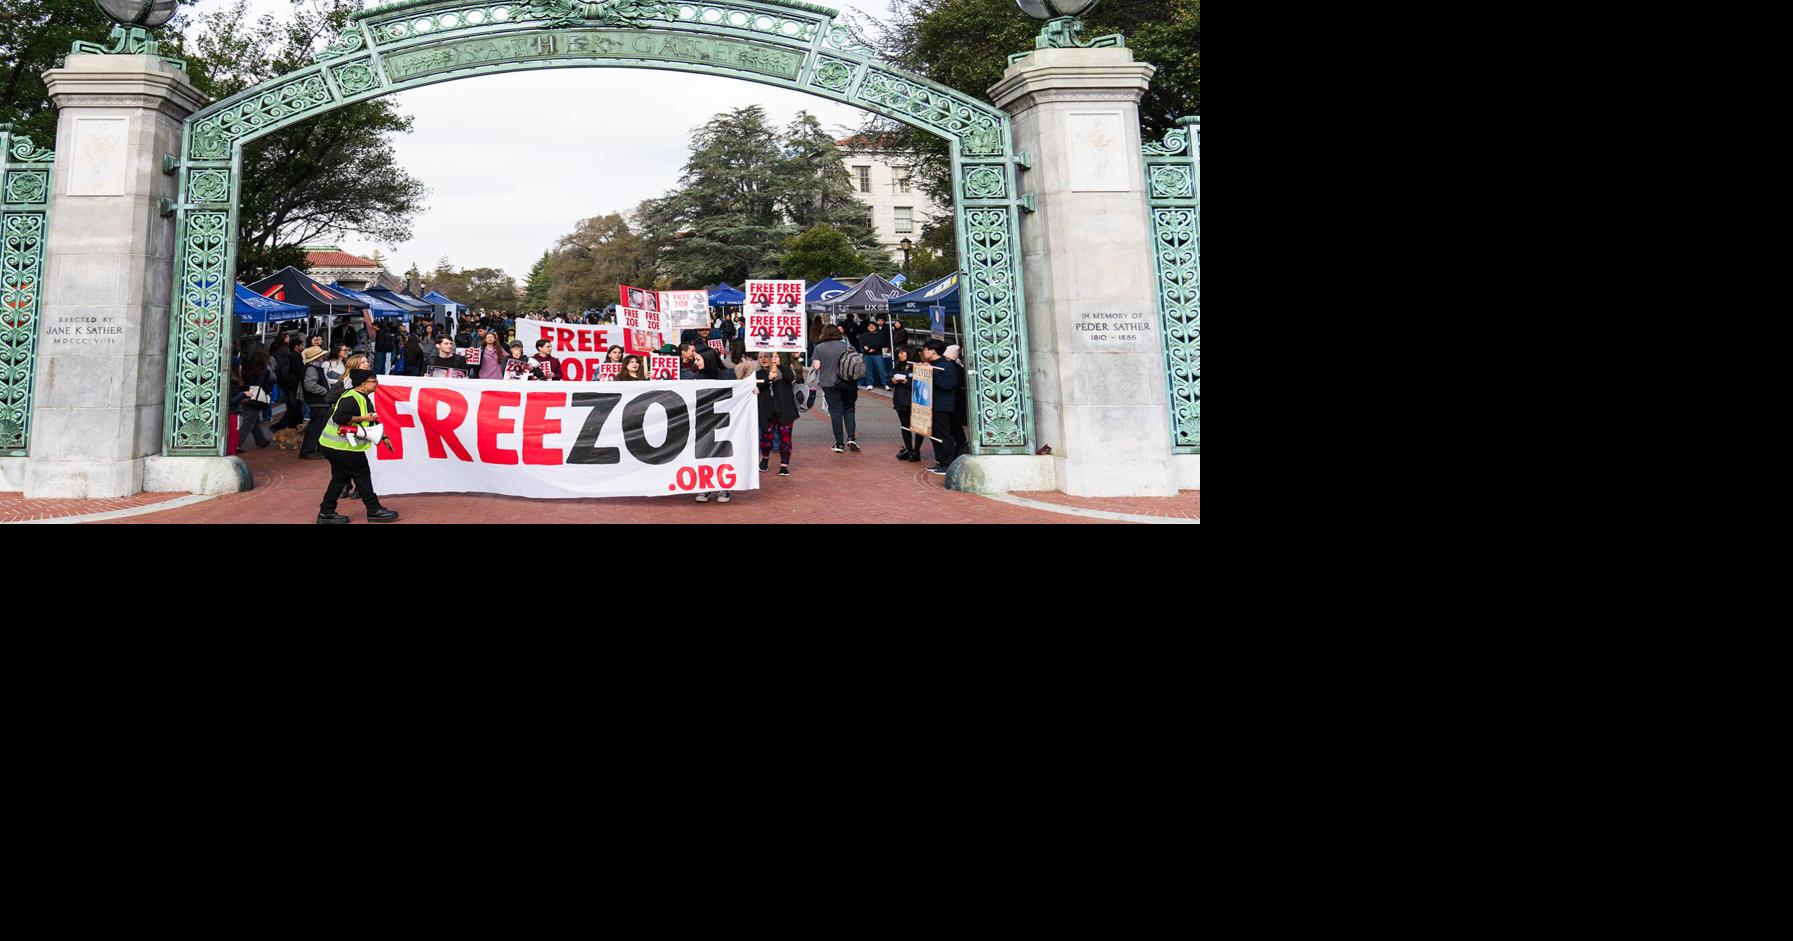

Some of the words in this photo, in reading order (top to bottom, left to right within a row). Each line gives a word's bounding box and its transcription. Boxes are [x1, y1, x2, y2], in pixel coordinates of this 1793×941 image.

[463, 35, 612, 60] SATHER
[632, 36, 730, 61] GATE
[750, 283, 775, 293] FREE
[777, 283, 802, 293] FREE
[673, 293, 690, 301] FREE
[750, 293, 775, 304] ZOE
[777, 293, 802, 304] ZOE
[624, 309, 639, 318] FREE
[645, 312, 660, 321] FREE
[626, 318, 639, 327] ZOE
[647, 321, 660, 330] ZOE
[750, 316, 775, 325] FREE
[777, 316, 802, 325] FREE
[46, 327, 71, 335] JANE
[75, 327, 82, 335] K
[86, 327, 123, 335] SATHER
[750, 326, 775, 337] ZOE
[777, 326, 802, 337] ZOE
[1075, 323, 1109, 331] PEDER
[1113, 323, 1151, 331] SATHER
[540, 326, 608, 352] FREE
[652, 357, 679, 368] FREE
[601, 364, 622, 373] FREE
[651, 369, 679, 380] ZOE
[668, 464, 737, 491] .ORG
